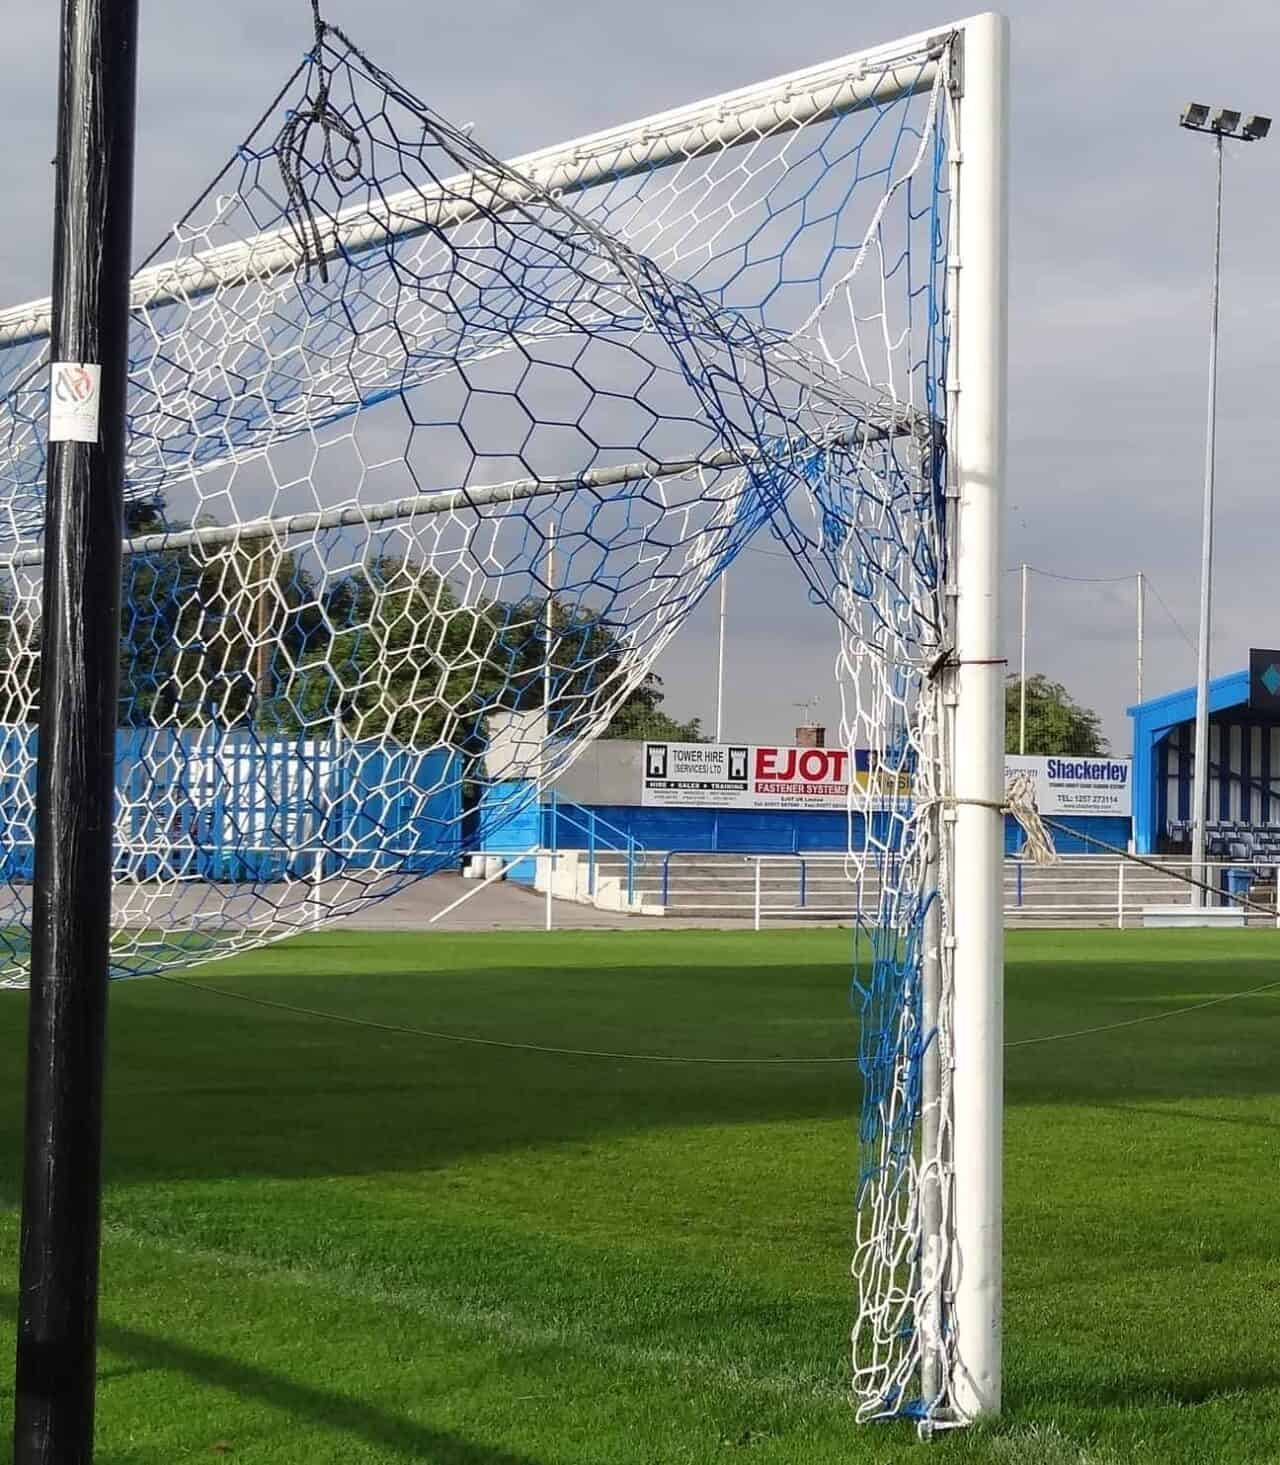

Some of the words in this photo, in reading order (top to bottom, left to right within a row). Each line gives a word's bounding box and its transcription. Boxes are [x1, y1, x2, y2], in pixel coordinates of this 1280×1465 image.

[672, 750, 703, 762] TOWER
[704, 751, 724, 763] HIRE
[709, 764, 722, 775] LTD
[755, 748, 849, 782] EJOT
[1047, 759, 1128, 783] Shackerley
[757, 783, 805, 794] FASTENER
[806, 784, 847, 795] SYSTEMS
